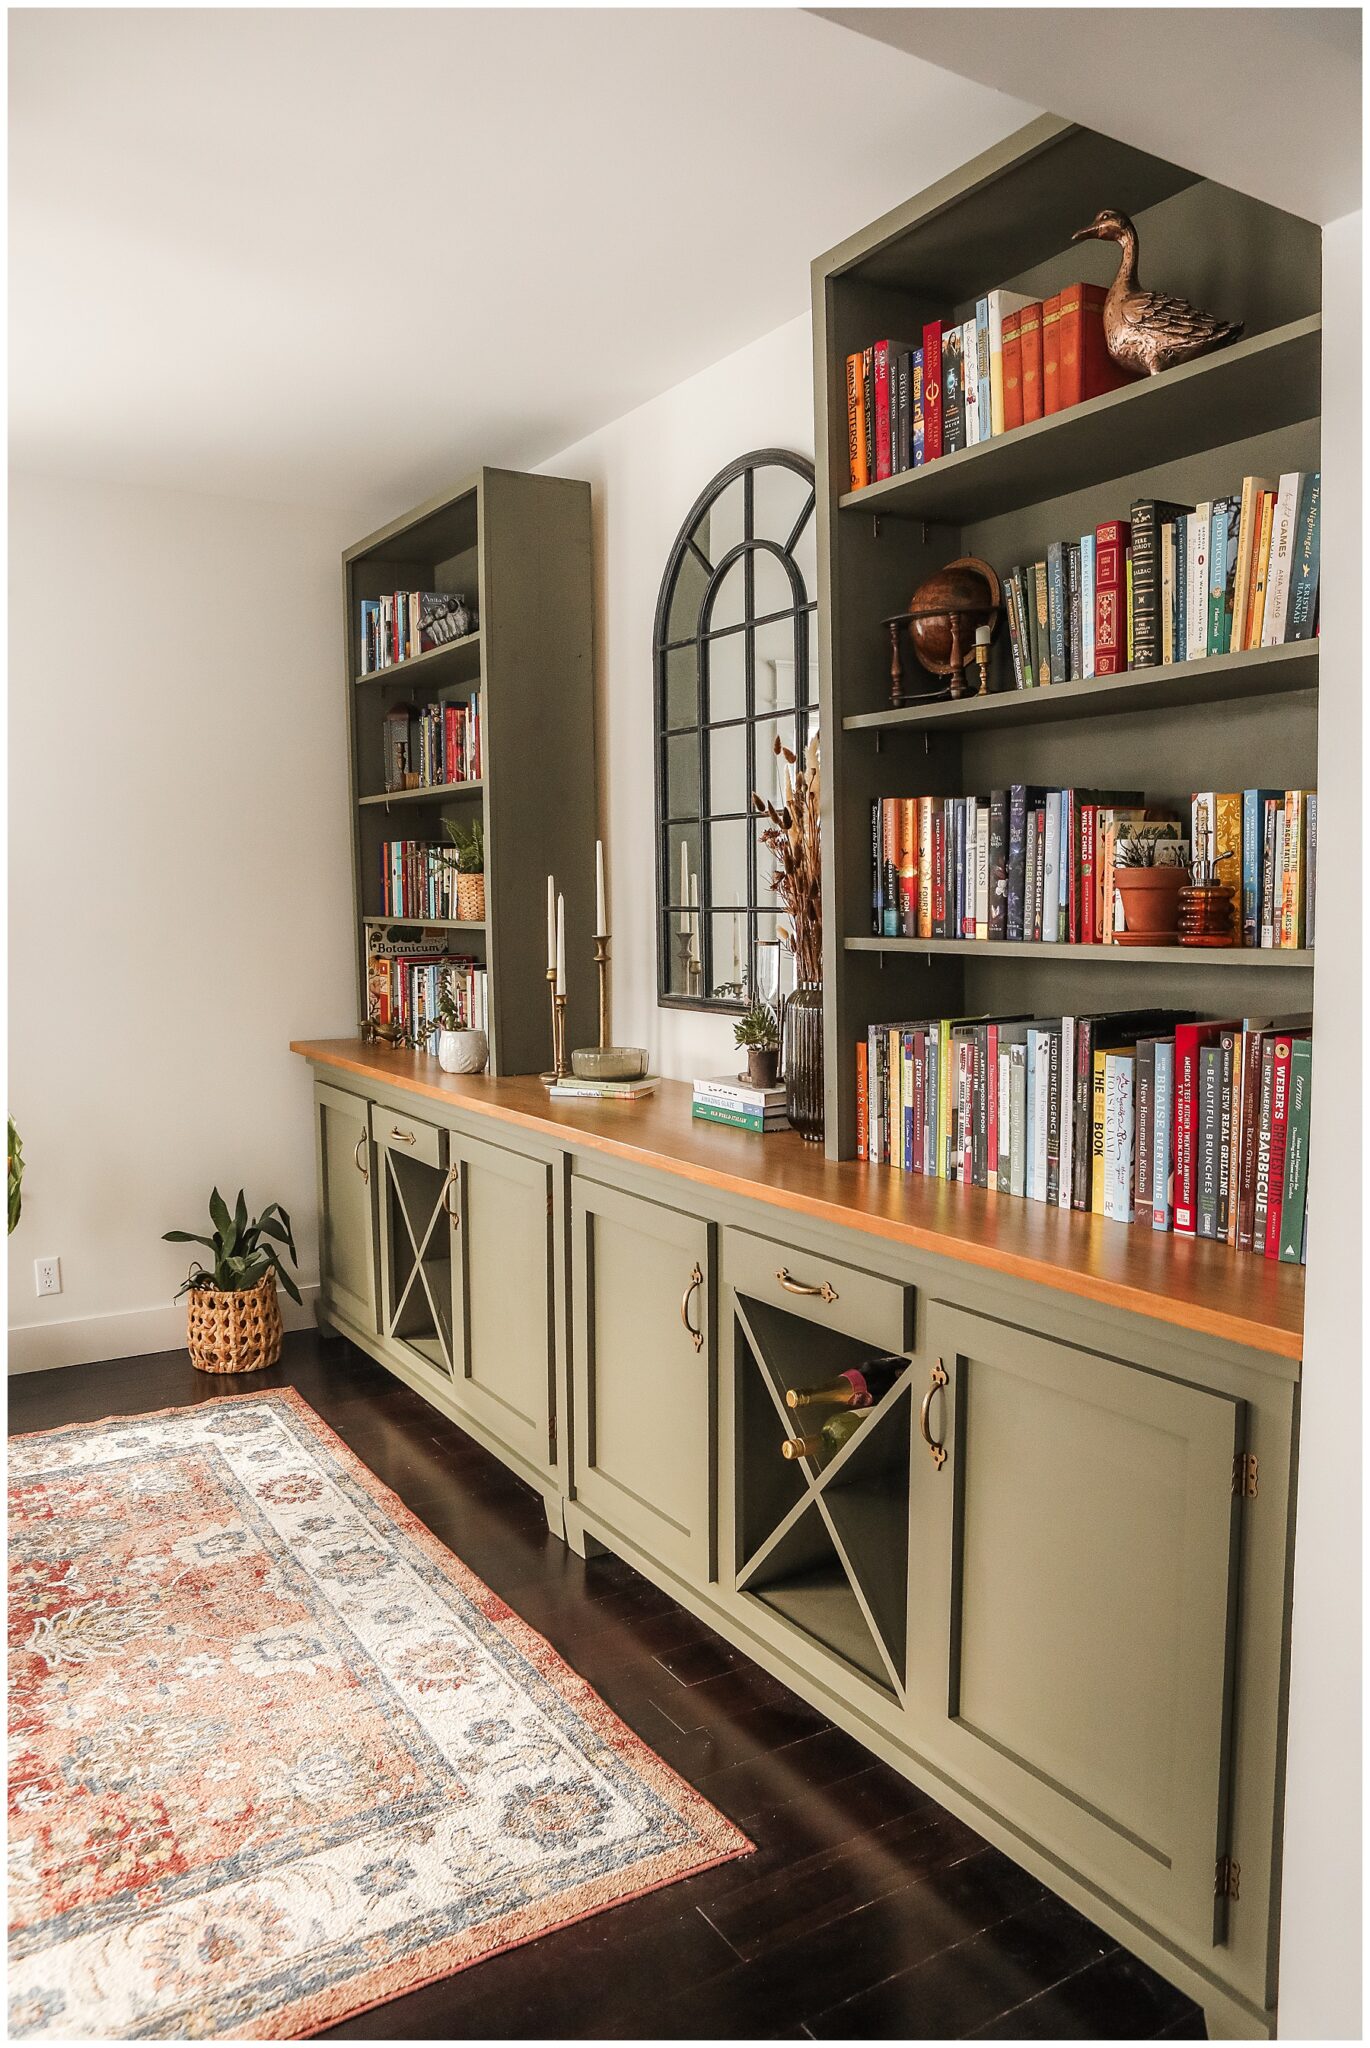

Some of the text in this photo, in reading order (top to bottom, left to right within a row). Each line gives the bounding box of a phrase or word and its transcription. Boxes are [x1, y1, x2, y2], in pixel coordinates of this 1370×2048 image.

[879, 350, 887, 380] SARAH
[899, 373, 908, 410] GEISHA
[946, 368, 956, 400] HOST
[846, 360, 859, 461] JAMES PATTERSON
[1215, 517, 1224, 541] JODI
[1279, 519, 1289, 558] GAMES
[1303, 487, 1320, 559] The Nightingale
[1199, 569, 1204, 579] We
[1214, 542, 1223, 584] PICOULT
[1275, 589, 1283, 619] HUANG
[1293, 582, 1304, 624] HANNAH
[1301, 583, 1311, 622] KRISTIN
[1015, 657, 1024, 690] BRADBURY
[979, 842, 987, 886] THINGS
[1264, 865, 1272, 895] Wrinkle
[377, 943, 440, 958] Botanicum
[915, 1059, 923, 1088] graze
[1177, 1083, 1183, 1096] TV
[1183, 1056, 1191, 1087] AMERICA'S
[1183, 1089, 1191, 1103] TEST
[1222, 1086, 1230, 1109] NEW
[1294, 1075, 1305, 1112] terrain
[1012, 1100, 1020, 1127] simply
[1094, 1069, 1105, 1157] THE BEE BOOK
[1204, 1069, 1214, 1194] BEAUTIFUL BRUNCHES
[1221, 1113, 1230, 1141] REAL
[1012, 1129, 1020, 1153] living
[1139, 1083, 1148, 1193] New Homemade Kitchen
[1155, 1074, 1166, 1199] BRAISE EVERYTHING
[1256, 1065, 1271, 1213] NEW AMERICAN BARBECUE
[1270, 1065, 1286, 1205] WEBER'S GREATEST HITS
[1219, 1144, 1229, 1196] GRILLING
[1244, 1149, 1253, 1189] GRILLING
